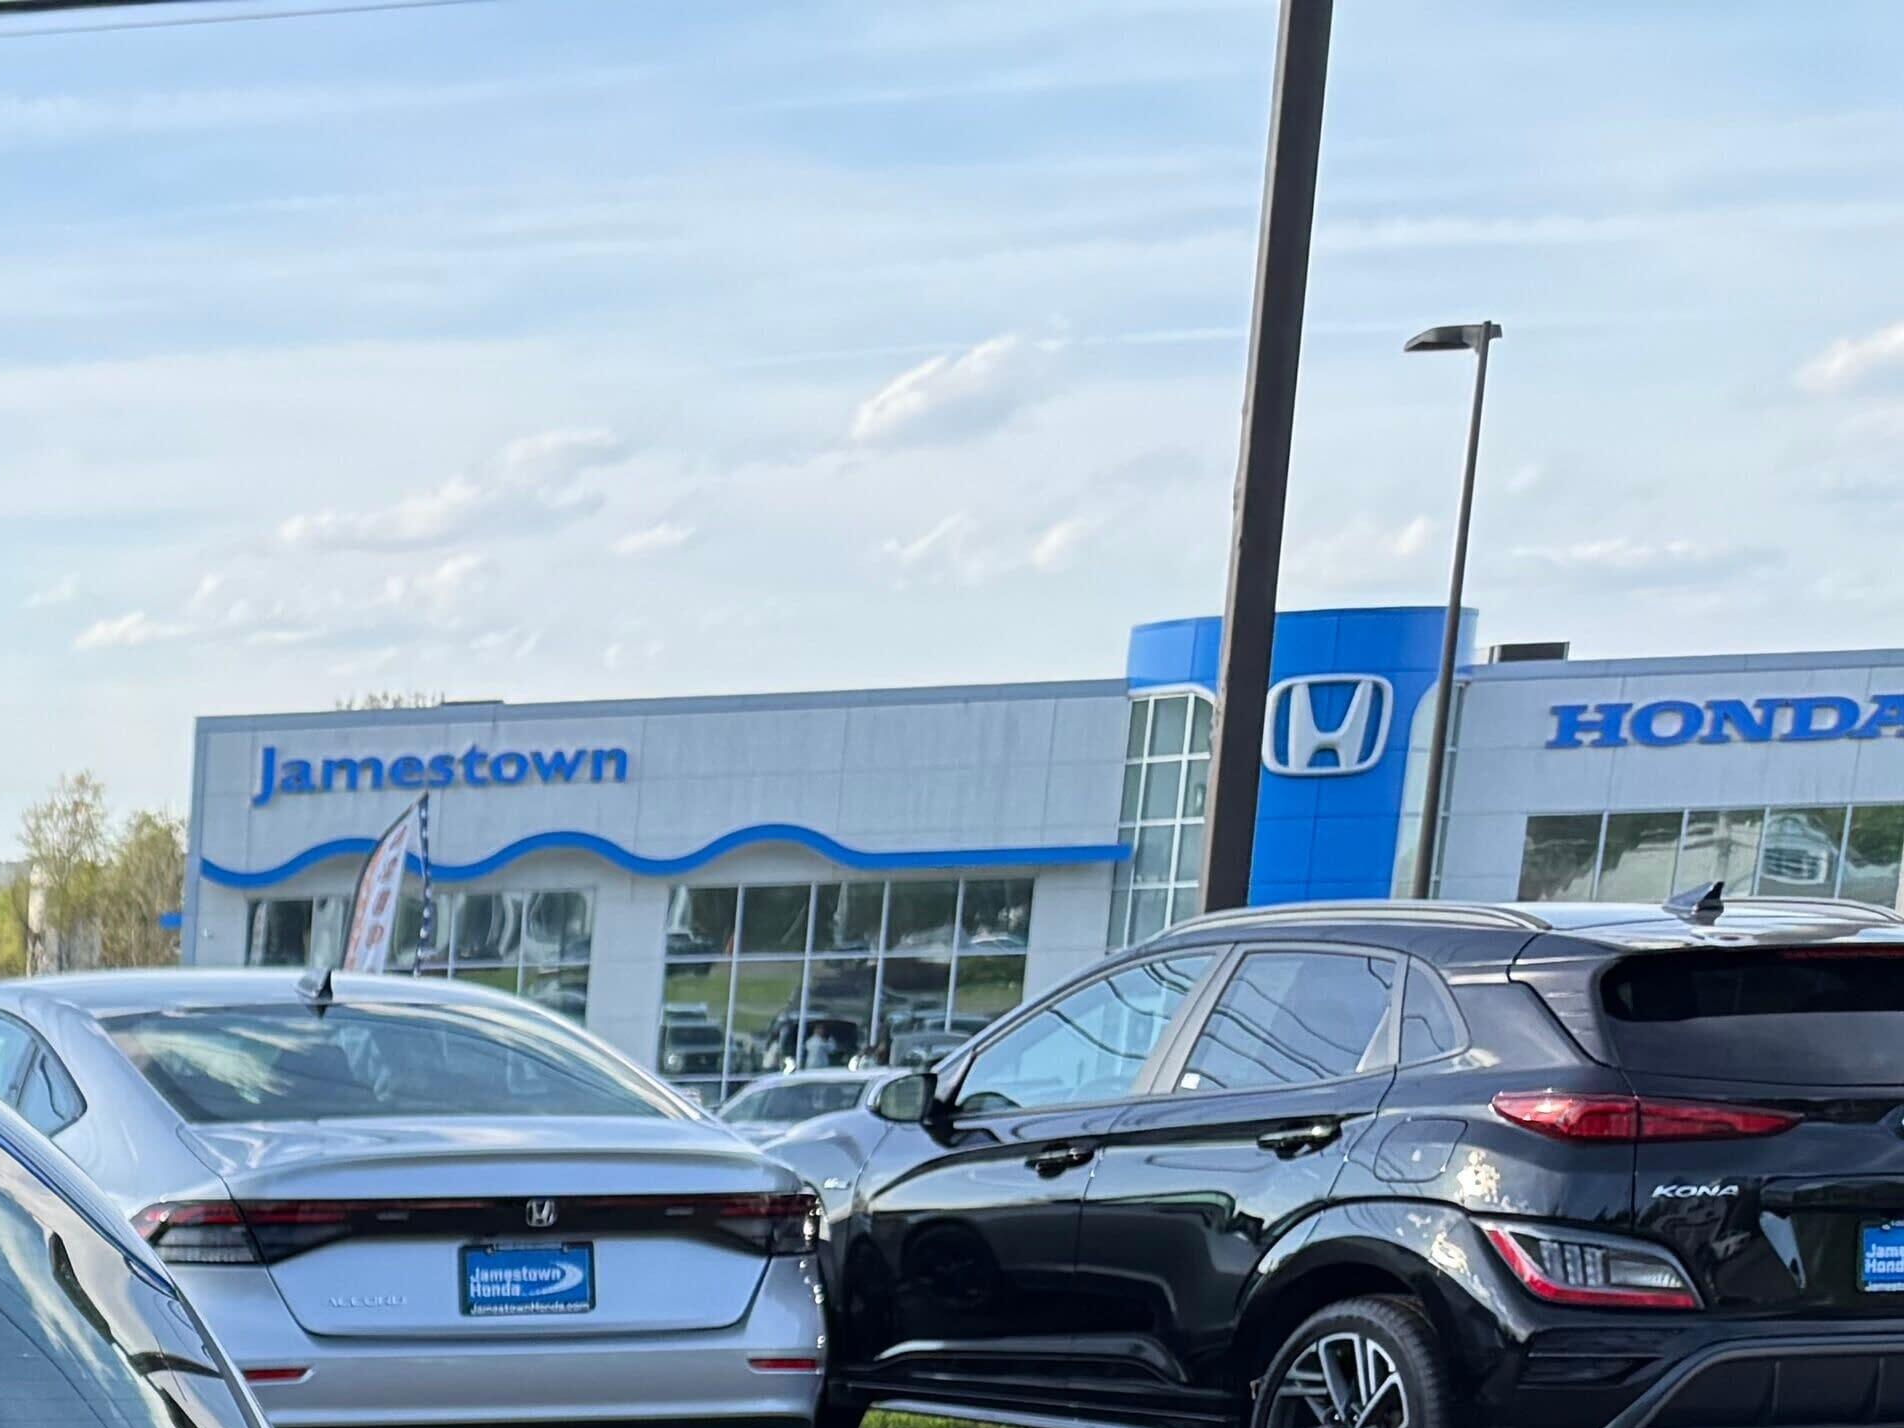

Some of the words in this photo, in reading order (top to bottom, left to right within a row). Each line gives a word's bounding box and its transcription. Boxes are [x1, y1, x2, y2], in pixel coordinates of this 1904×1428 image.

[252, 743, 629, 806] Jamestown
[1652, 1184, 1739, 1198] KONA
[470, 1265, 562, 1283] Jamestown
[470, 1280, 521, 1298] Honda
